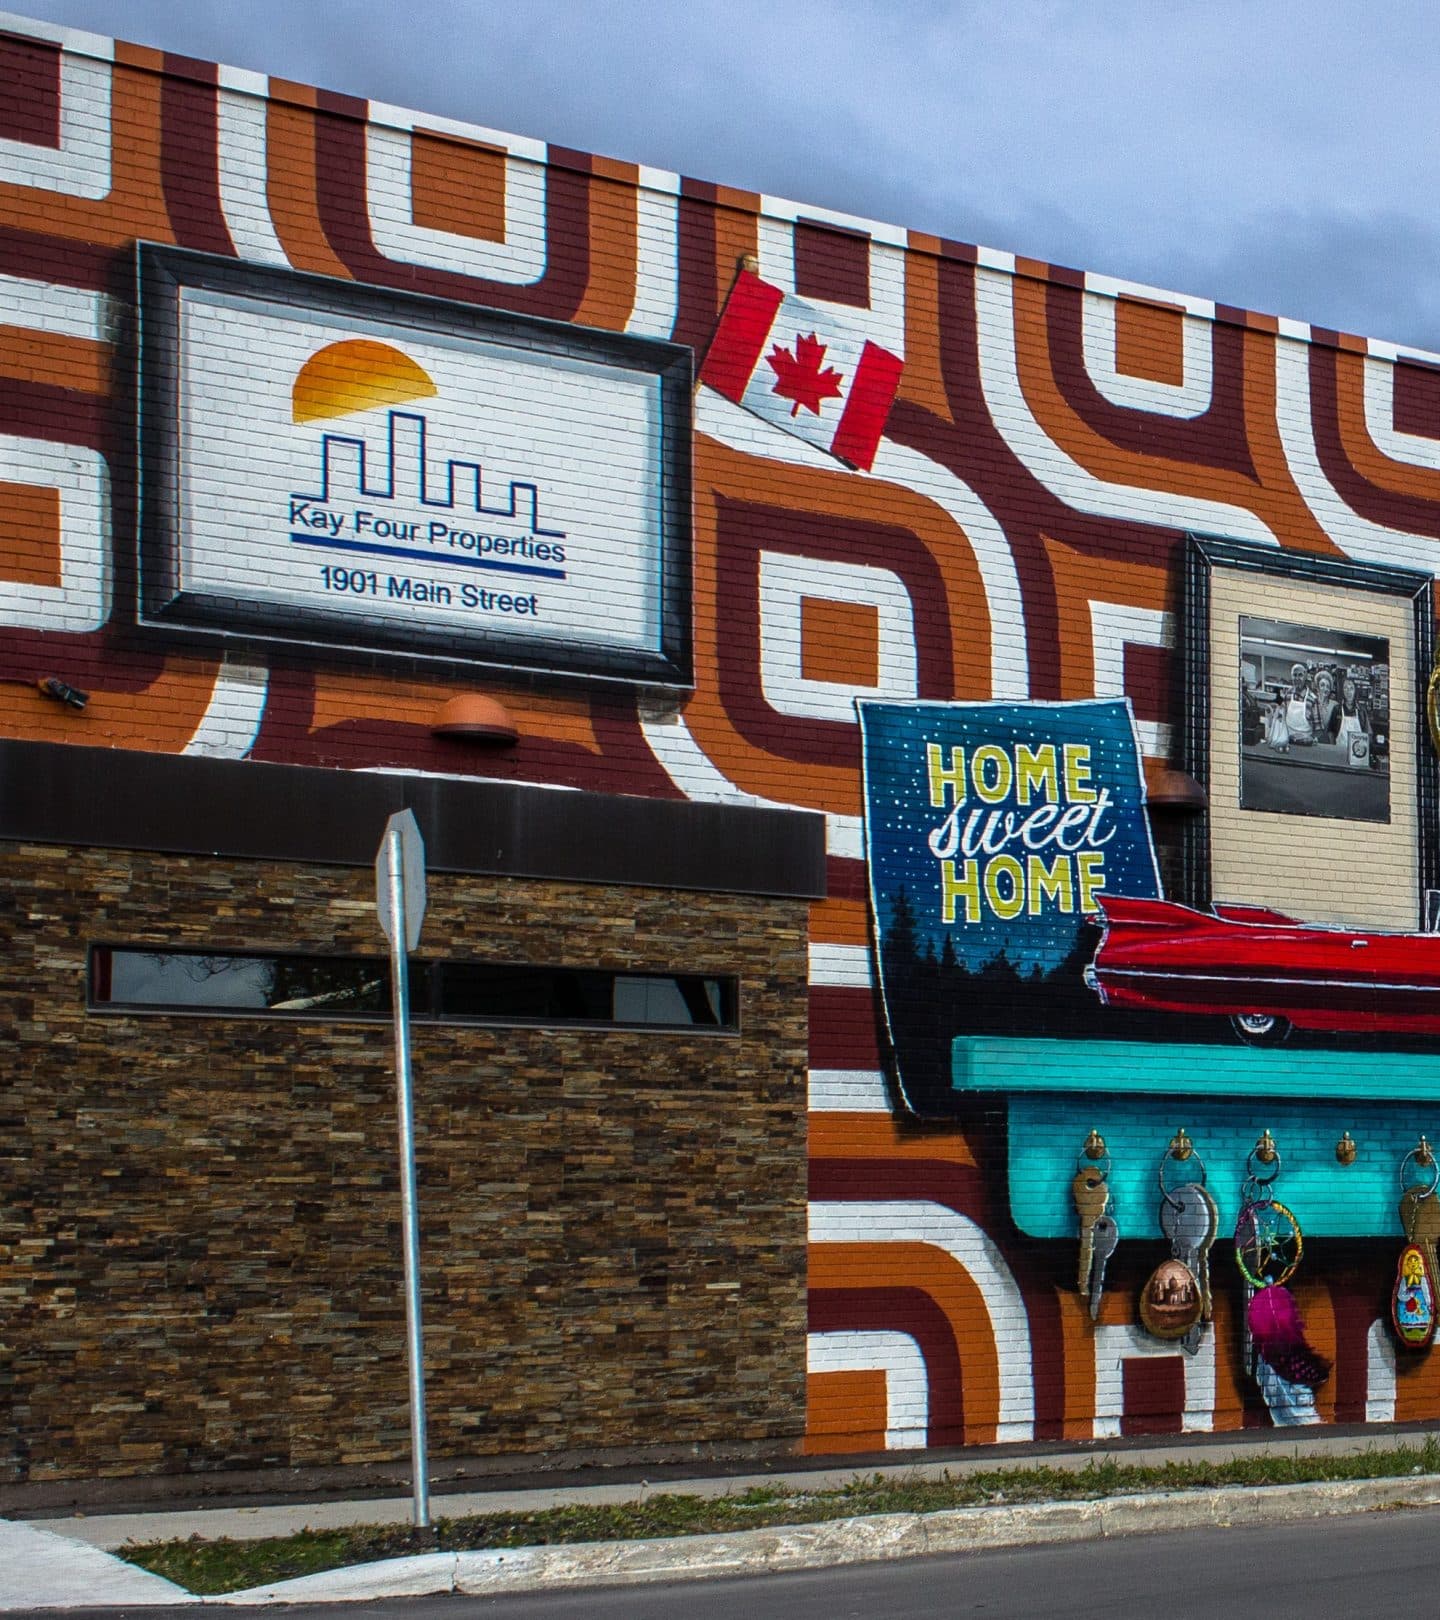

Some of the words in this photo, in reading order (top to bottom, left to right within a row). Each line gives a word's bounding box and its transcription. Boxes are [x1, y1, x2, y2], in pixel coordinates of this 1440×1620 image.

[289, 500, 344, 536] Kay
[355, 510, 420, 541] Four
[428, 521, 566, 562] Properties
[320, 565, 377, 595] 1901
[388, 576, 451, 604] Main
[460, 583, 538, 616] Street
[926, 742, 1098, 808] HOME
[940, 851, 1107, 924] HOME
